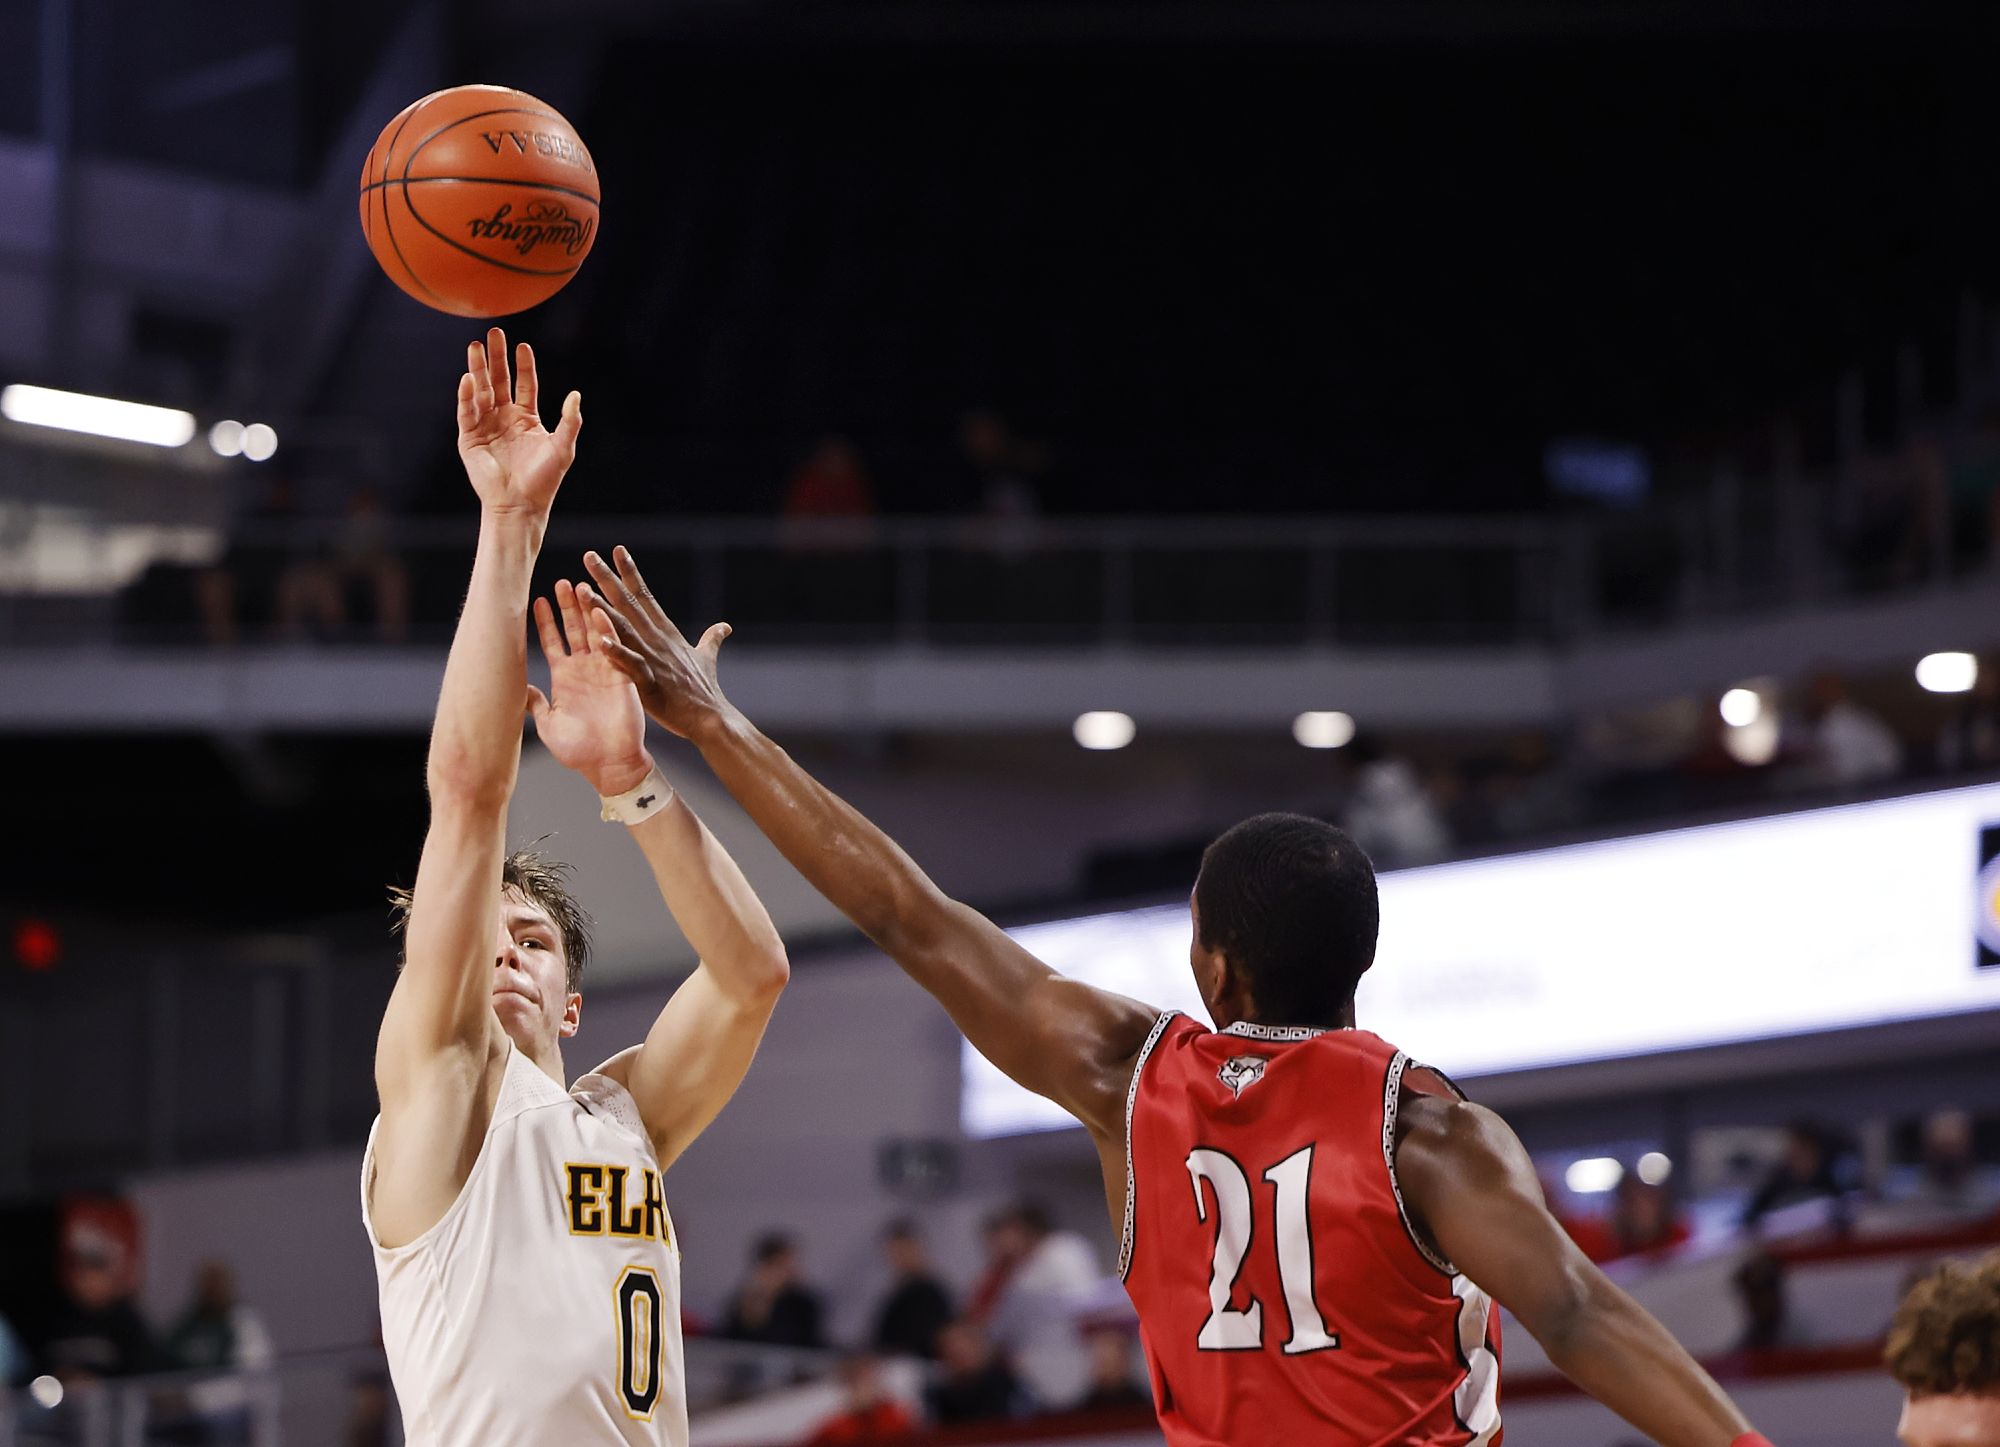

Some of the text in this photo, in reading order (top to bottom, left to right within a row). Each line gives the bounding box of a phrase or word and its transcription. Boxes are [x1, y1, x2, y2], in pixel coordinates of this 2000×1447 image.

[467, 203, 593, 255] Rawlings
[1185, 1141, 1341, 1354] 21
[611, 1265, 665, 1423] 0
